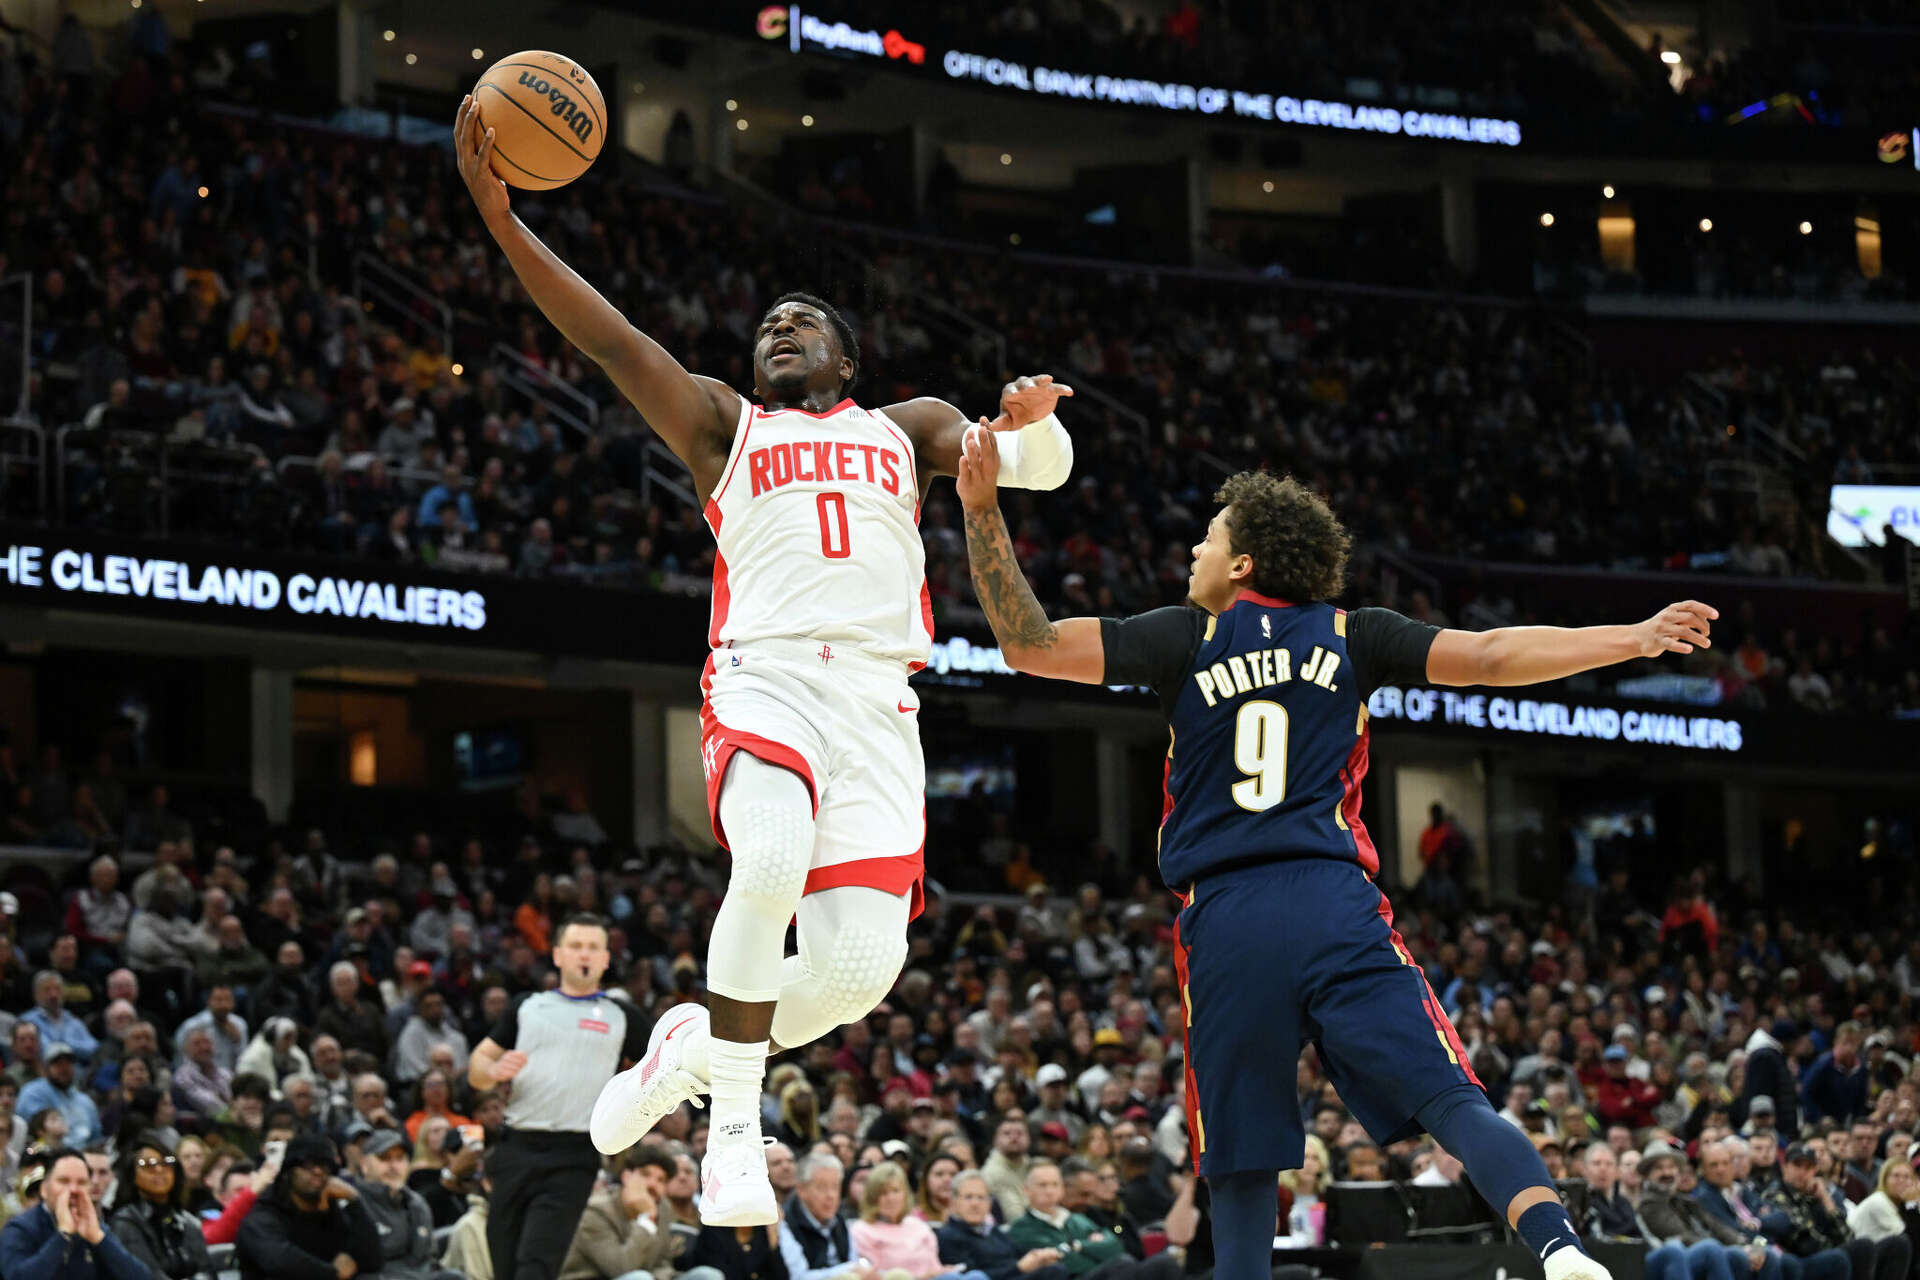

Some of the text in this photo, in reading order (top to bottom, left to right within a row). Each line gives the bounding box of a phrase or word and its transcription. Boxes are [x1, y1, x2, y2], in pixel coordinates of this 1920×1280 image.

[518, 71, 593, 145] Wilson
[1034, 67, 1094, 99] BANK
[1095, 75, 1197, 110] PARTNER
[1197, 87, 1228, 113] OF
[1233, 91, 1273, 119] THE
[1275, 96, 1401, 134] CLEVELAND
[1402, 110, 1521, 146] CAVALIERS
[748, 441, 900, 498] ROCKETS
[816, 491, 851, 559] 0
[51, 549, 282, 610] CLEVELAND
[287, 573, 487, 630] CAVALIERS
[1194, 646, 1341, 707] PORTER JR.
[1405, 688, 1438, 722] OF
[1442, 691, 1486, 728] THE
[1489, 697, 1621, 740] CLEVELAND
[1622, 710, 1742, 751] CAVALIERS
[1232, 700, 1289, 813] 9
